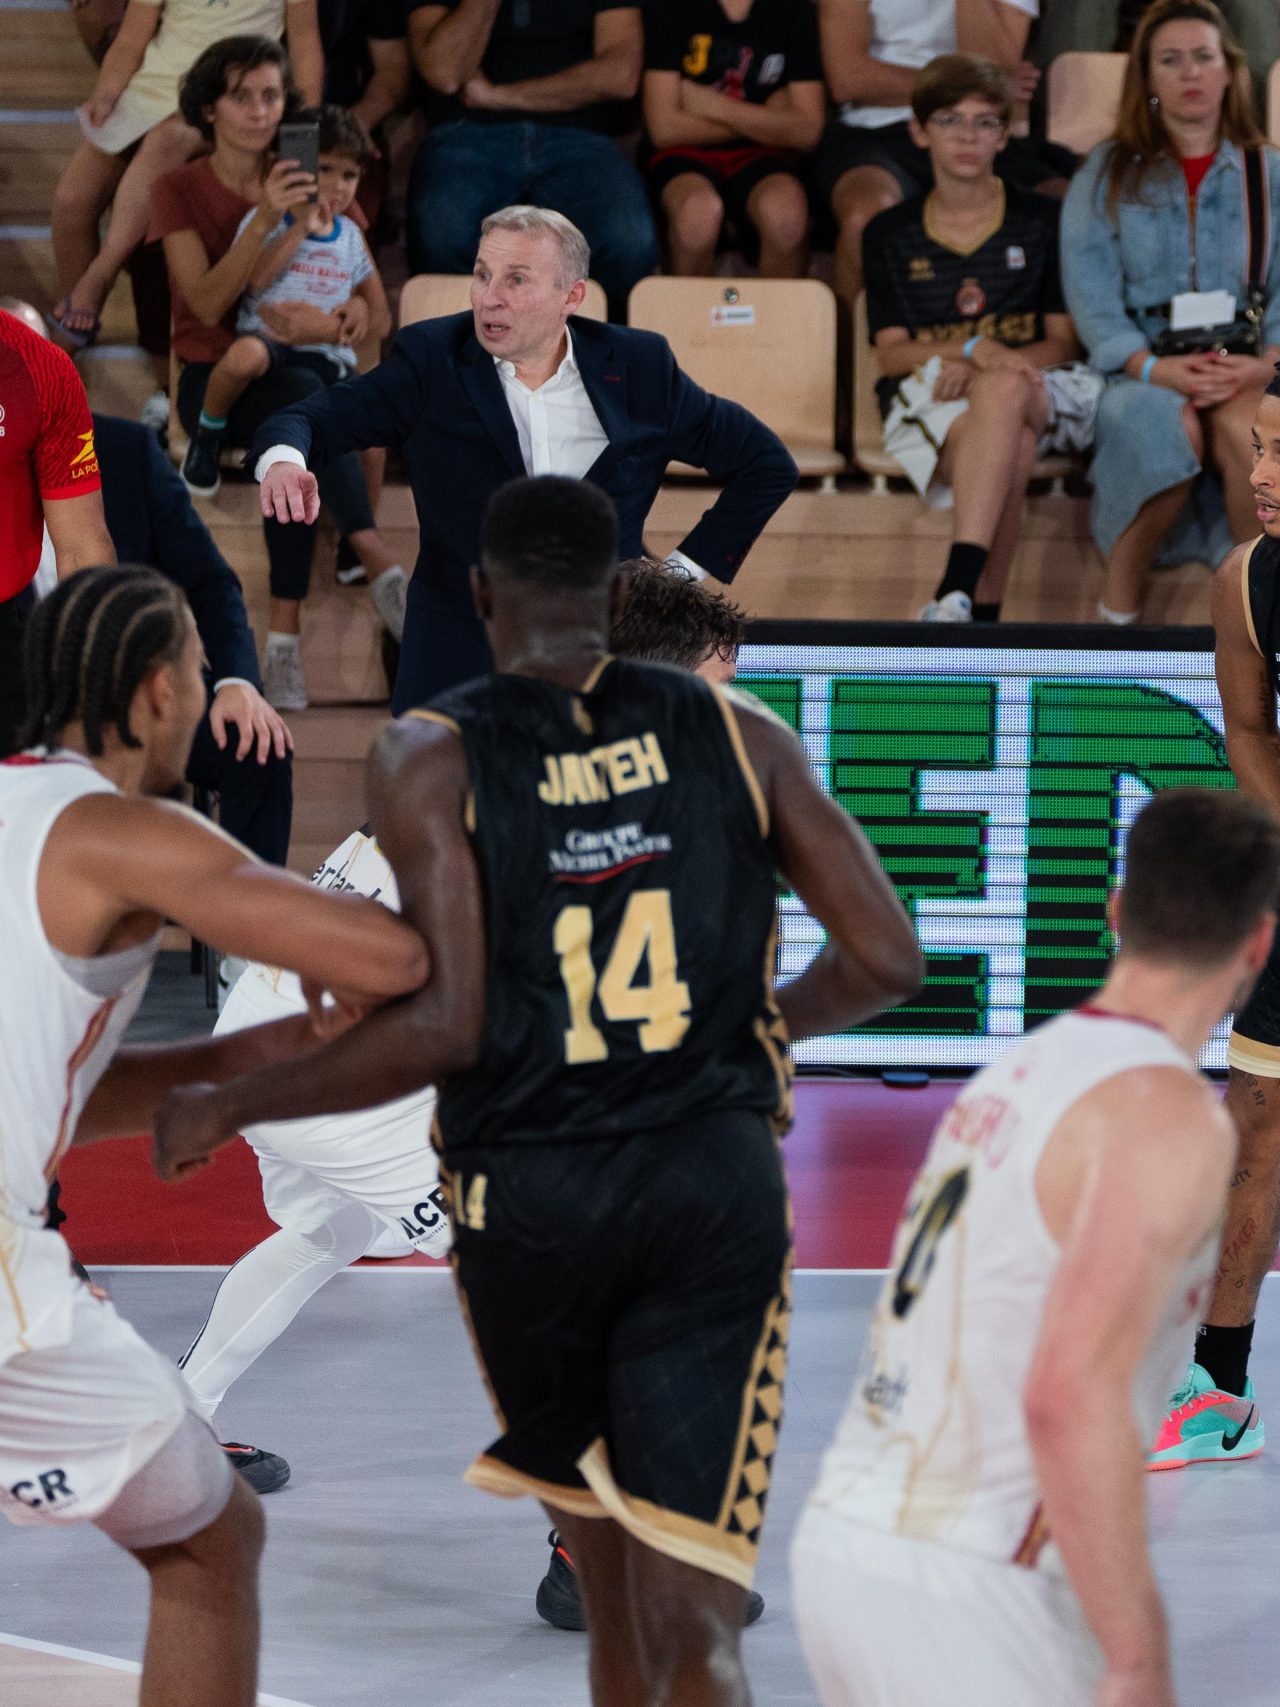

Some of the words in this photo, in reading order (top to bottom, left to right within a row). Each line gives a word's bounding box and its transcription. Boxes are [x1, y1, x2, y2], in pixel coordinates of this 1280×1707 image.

[72, 468, 85, 479] LA
[537, 731, 670, 806] JAITEH
[552, 886, 692, 1066] 14
[10, 1469, 74, 1508] CR
